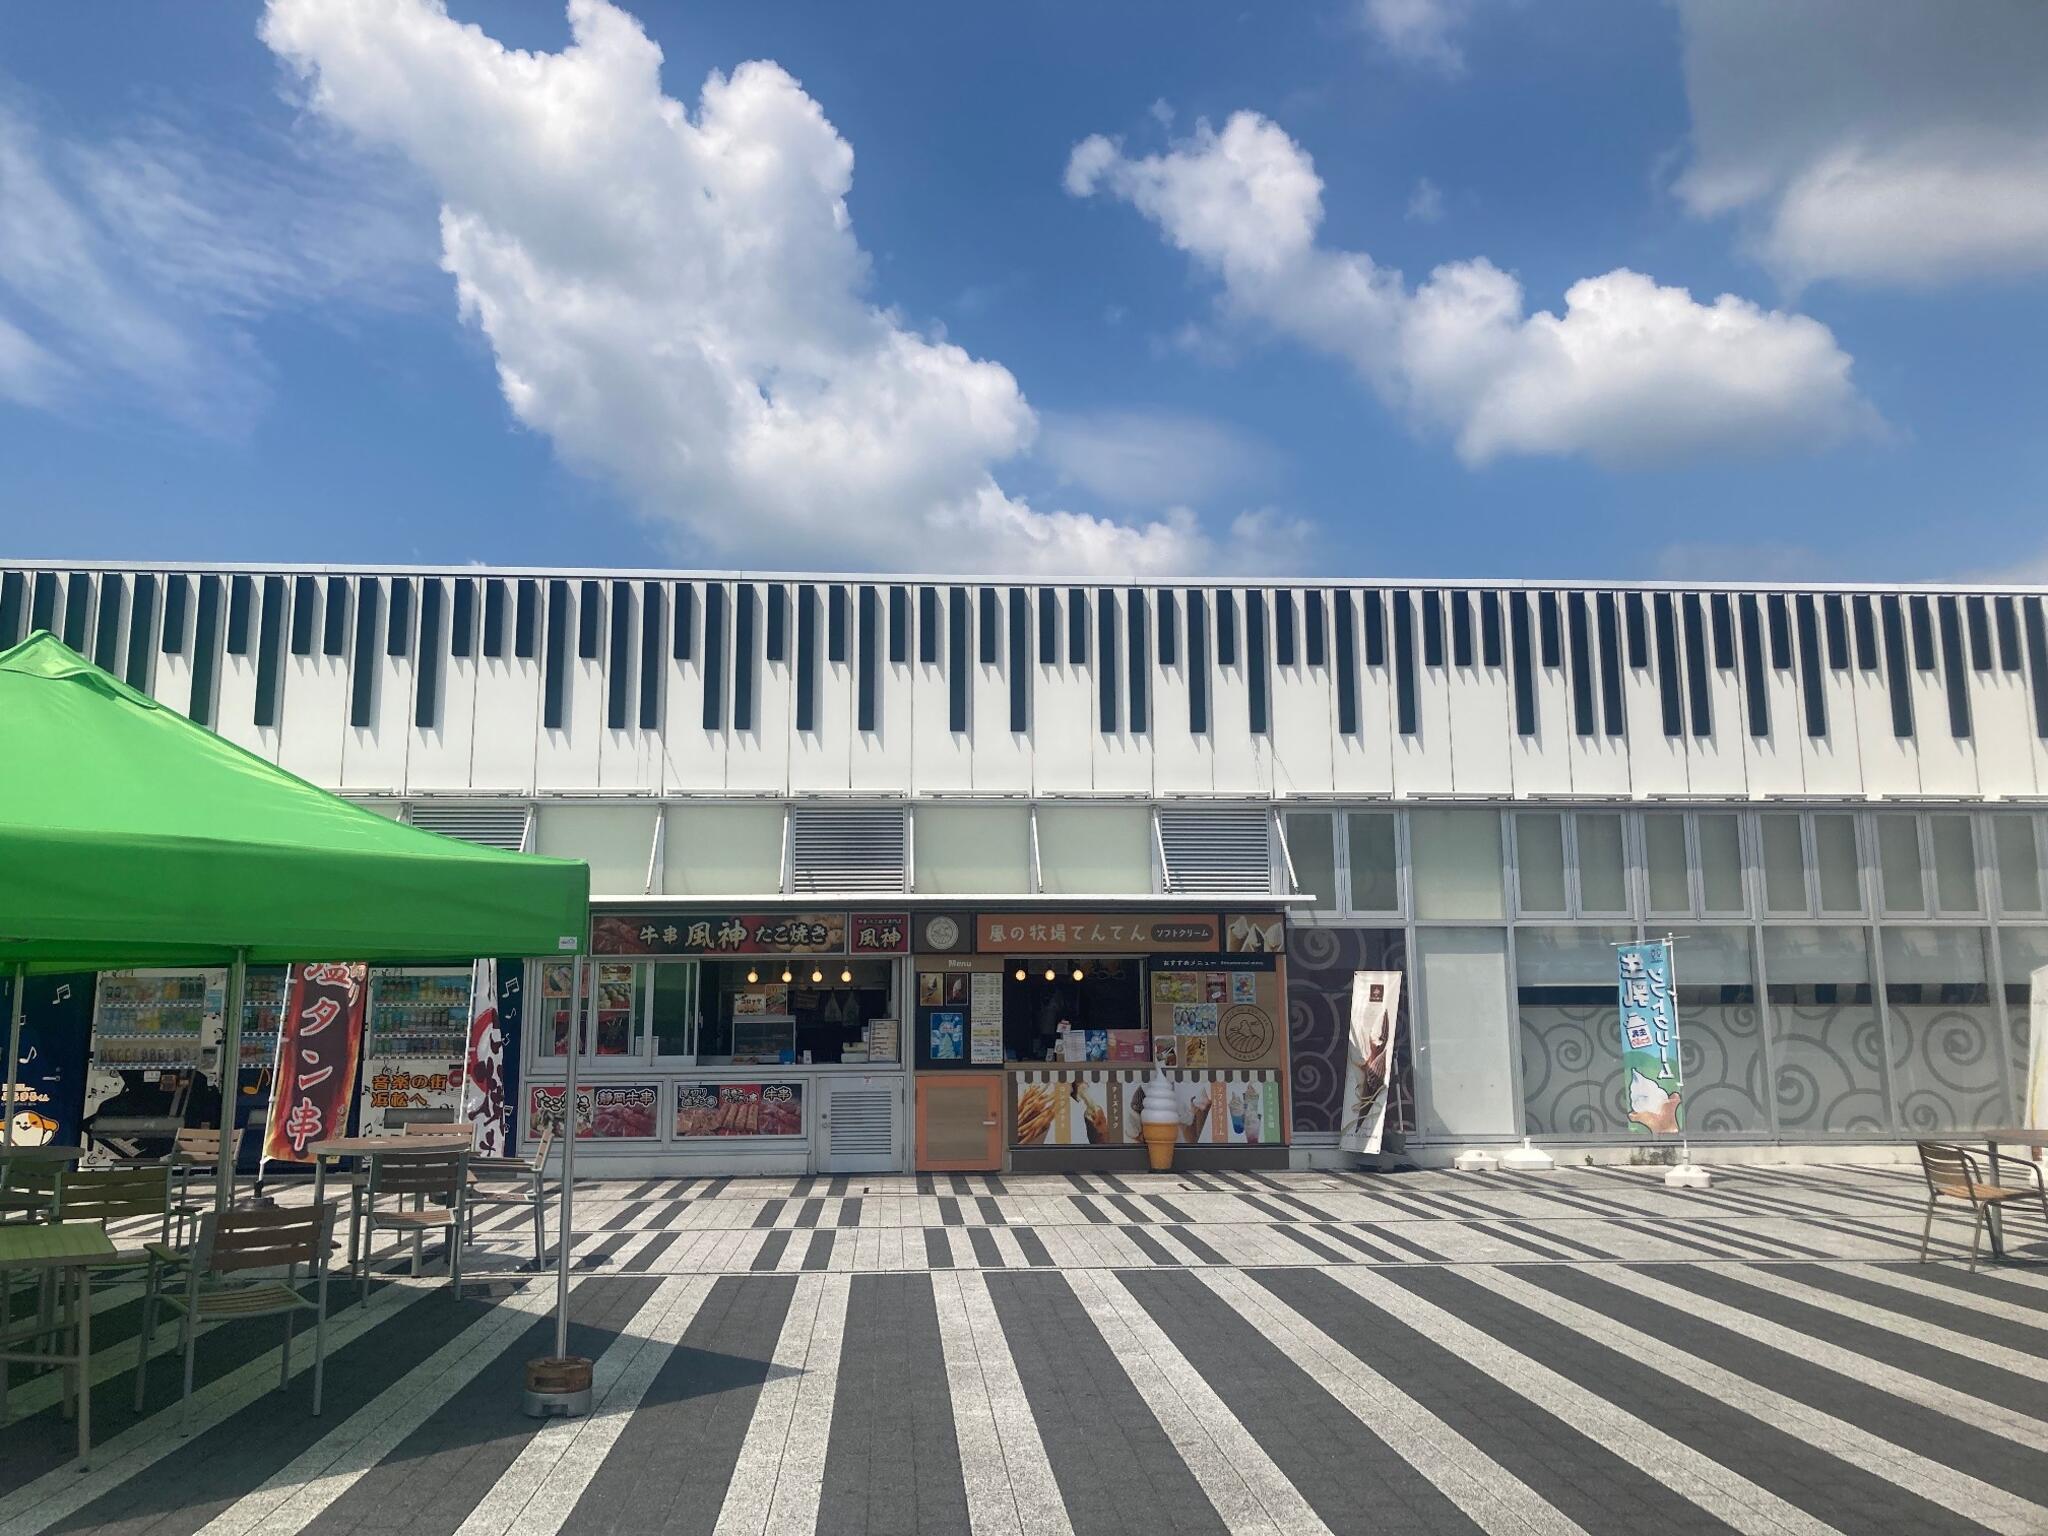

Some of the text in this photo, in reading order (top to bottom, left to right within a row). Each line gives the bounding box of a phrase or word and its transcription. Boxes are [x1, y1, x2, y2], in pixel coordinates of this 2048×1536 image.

[638, 918, 827, 950] 牛串 風神 たこ焼き
[857, 927, 902, 948] 風神
[988, 923, 1146, 943] 風の牧場てんてん
[1155, 927, 1210, 938] ソフトクリーム
[948, 959, 972, 967] Menu
[1162, 959, 1217, 967] おすすめメニュー
[371, 1074, 448, 1092] 音楽の街
[371, 1091, 429, 1107] 浜松へ
[533, 1087, 591, 1113] たこき
[763, 1086, 793, 1102] 牛串
